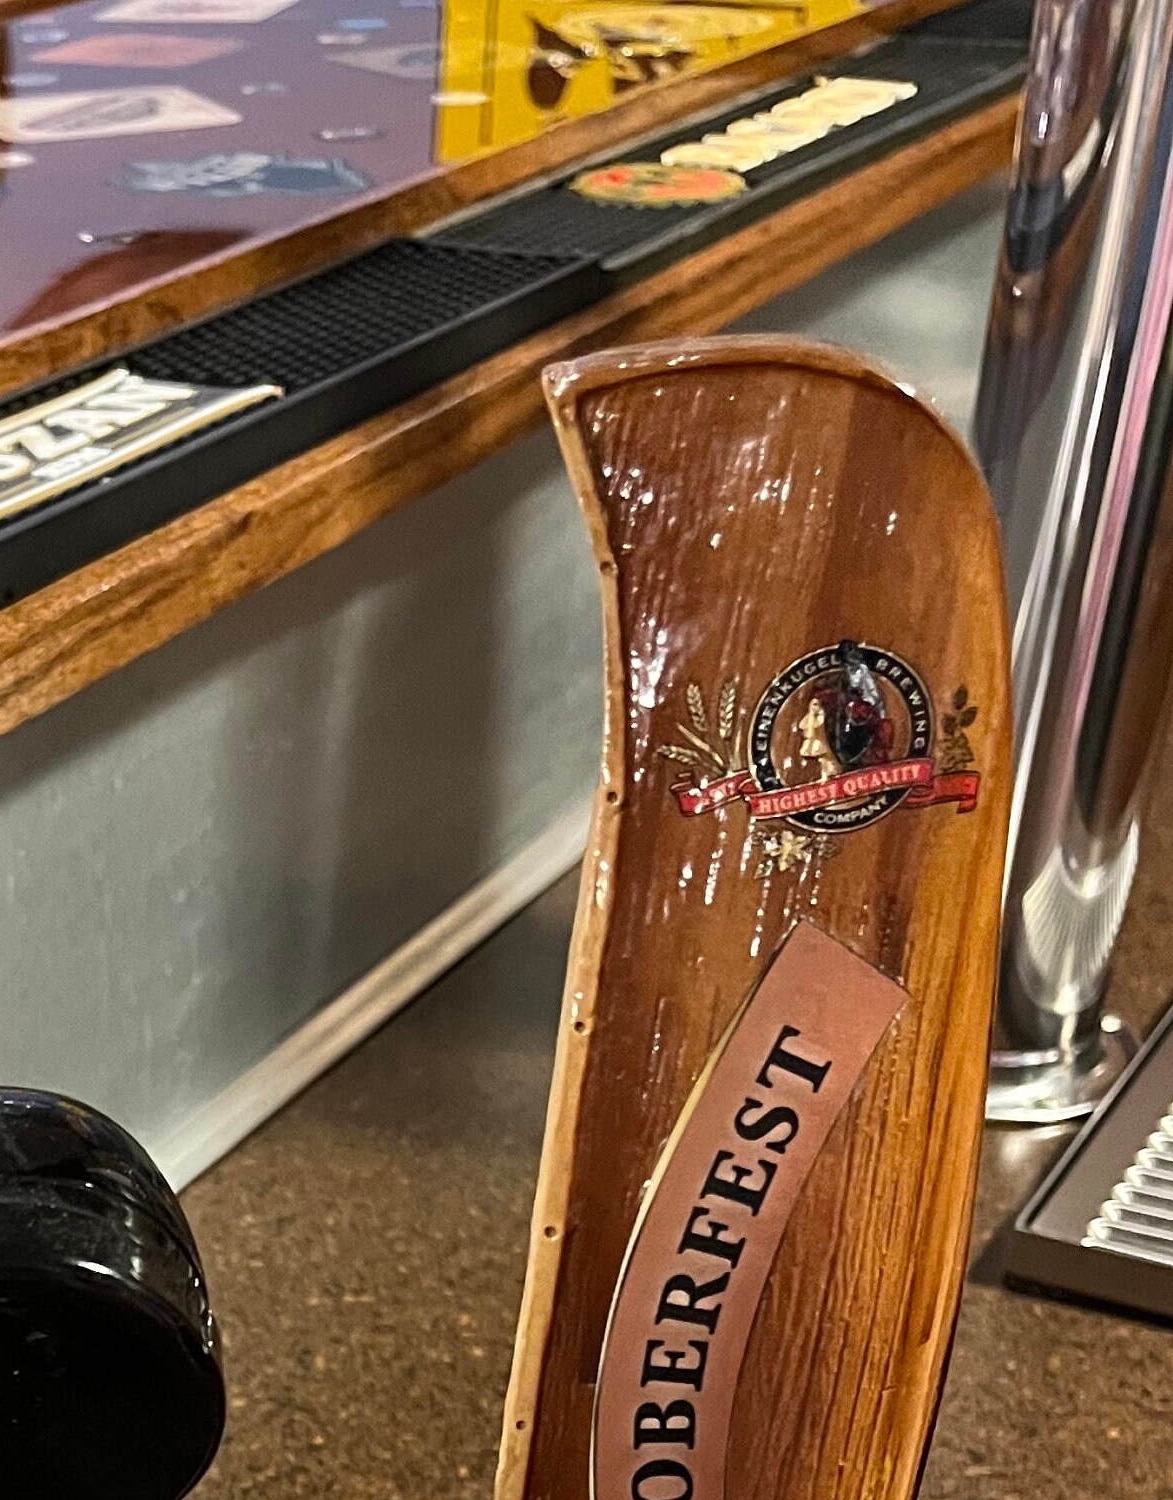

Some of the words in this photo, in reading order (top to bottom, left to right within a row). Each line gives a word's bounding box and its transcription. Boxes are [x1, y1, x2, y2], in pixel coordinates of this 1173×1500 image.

[876, 658, 927, 750] BREWING
[758, 783, 837, 813] HIGHEST
[843, 764, 921, 797] QUALITY
[813, 795, 888, 824] COMPANY
